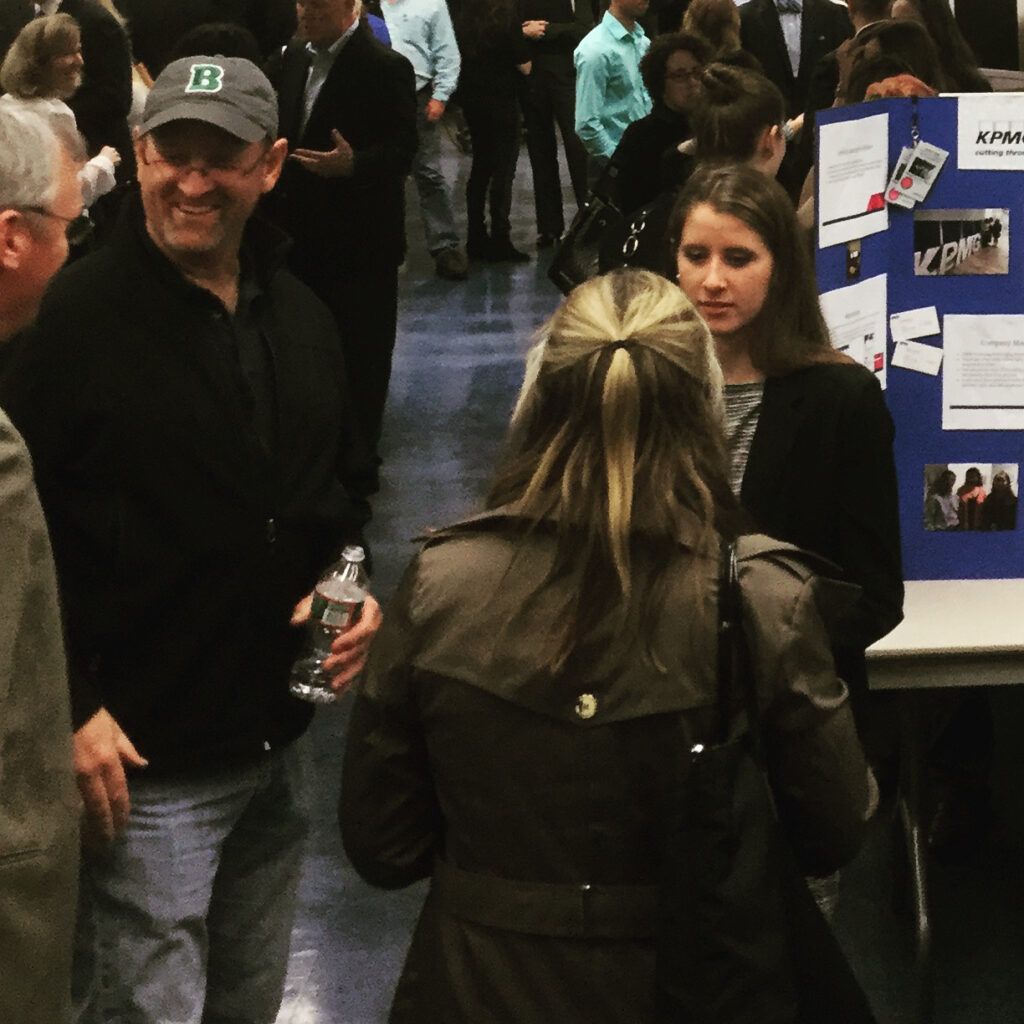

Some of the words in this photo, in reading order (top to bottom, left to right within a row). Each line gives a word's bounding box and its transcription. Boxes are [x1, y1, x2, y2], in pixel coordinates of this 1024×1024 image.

[184, 63, 224, 93] B
[974, 149, 1004, 158] cutting
[914, 233, 982, 276] KPMG
